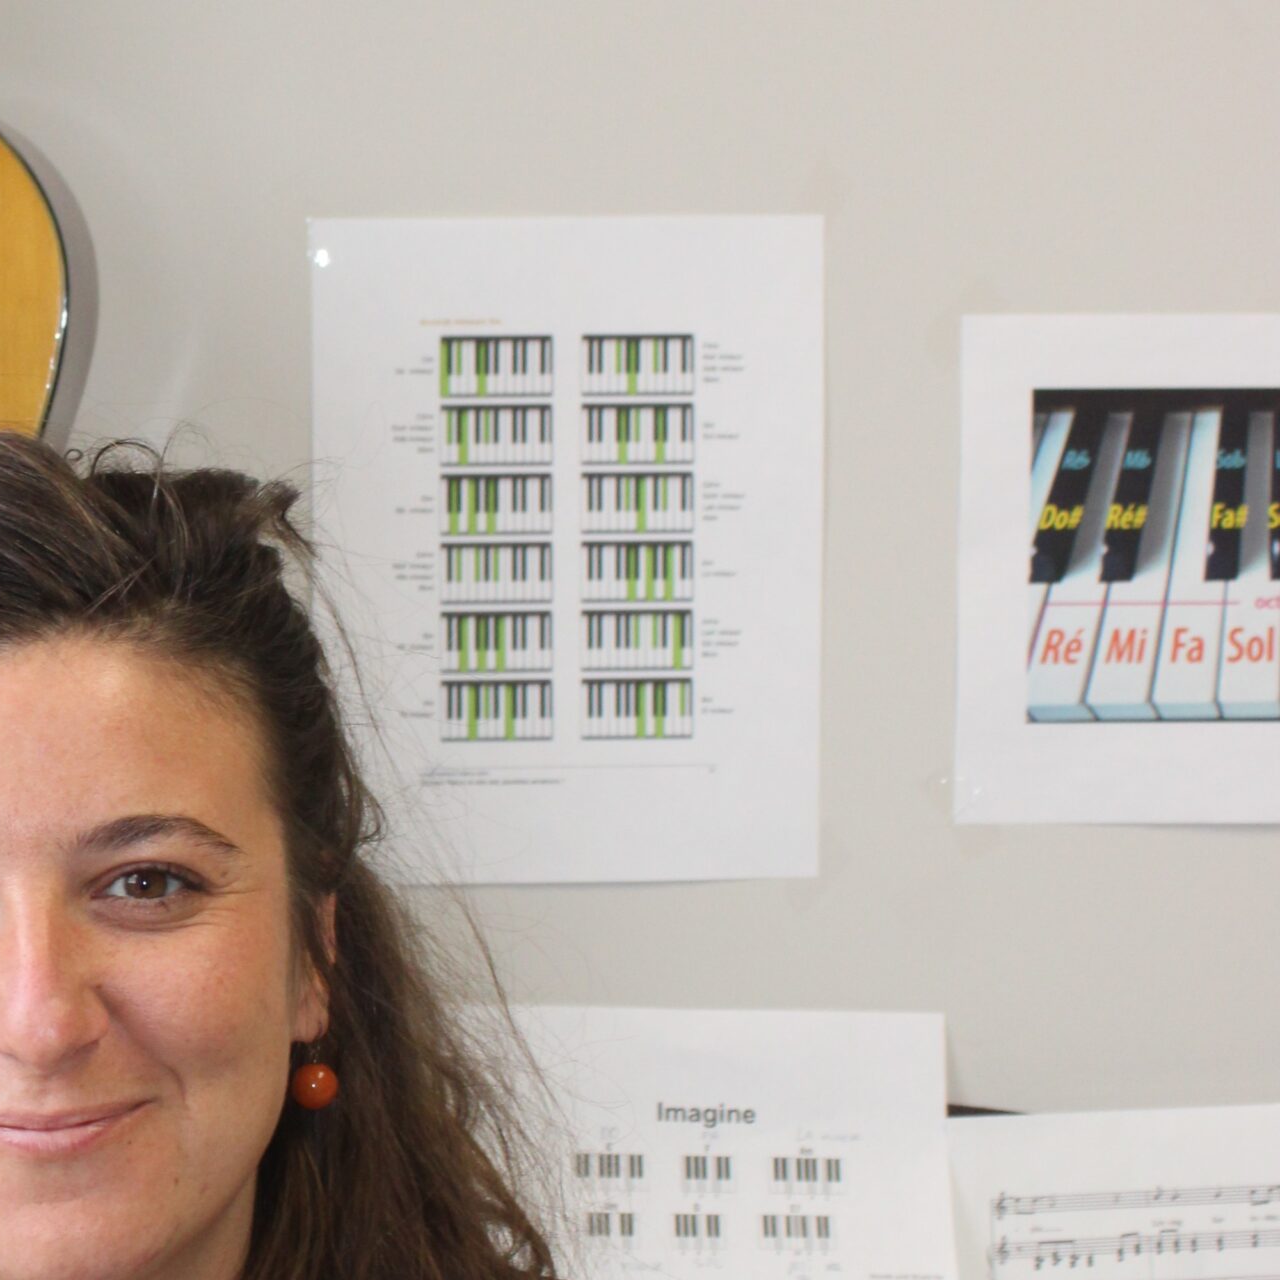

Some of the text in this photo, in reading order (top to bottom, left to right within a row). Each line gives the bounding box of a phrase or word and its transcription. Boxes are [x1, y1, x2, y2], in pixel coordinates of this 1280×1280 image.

[1038, 503, 1084, 530] Do#
[1106, 502, 1149, 530] Ré#
[1210, 502, 1249, 529] Fa#
[1040, 627, 1086, 665] Ré
[1105, 627, 1149, 664] Mi
[1170, 626, 1206, 664] Fa
[1227, 625, 1275, 663] Sol
[656, 1101, 757, 1129] Imagine
